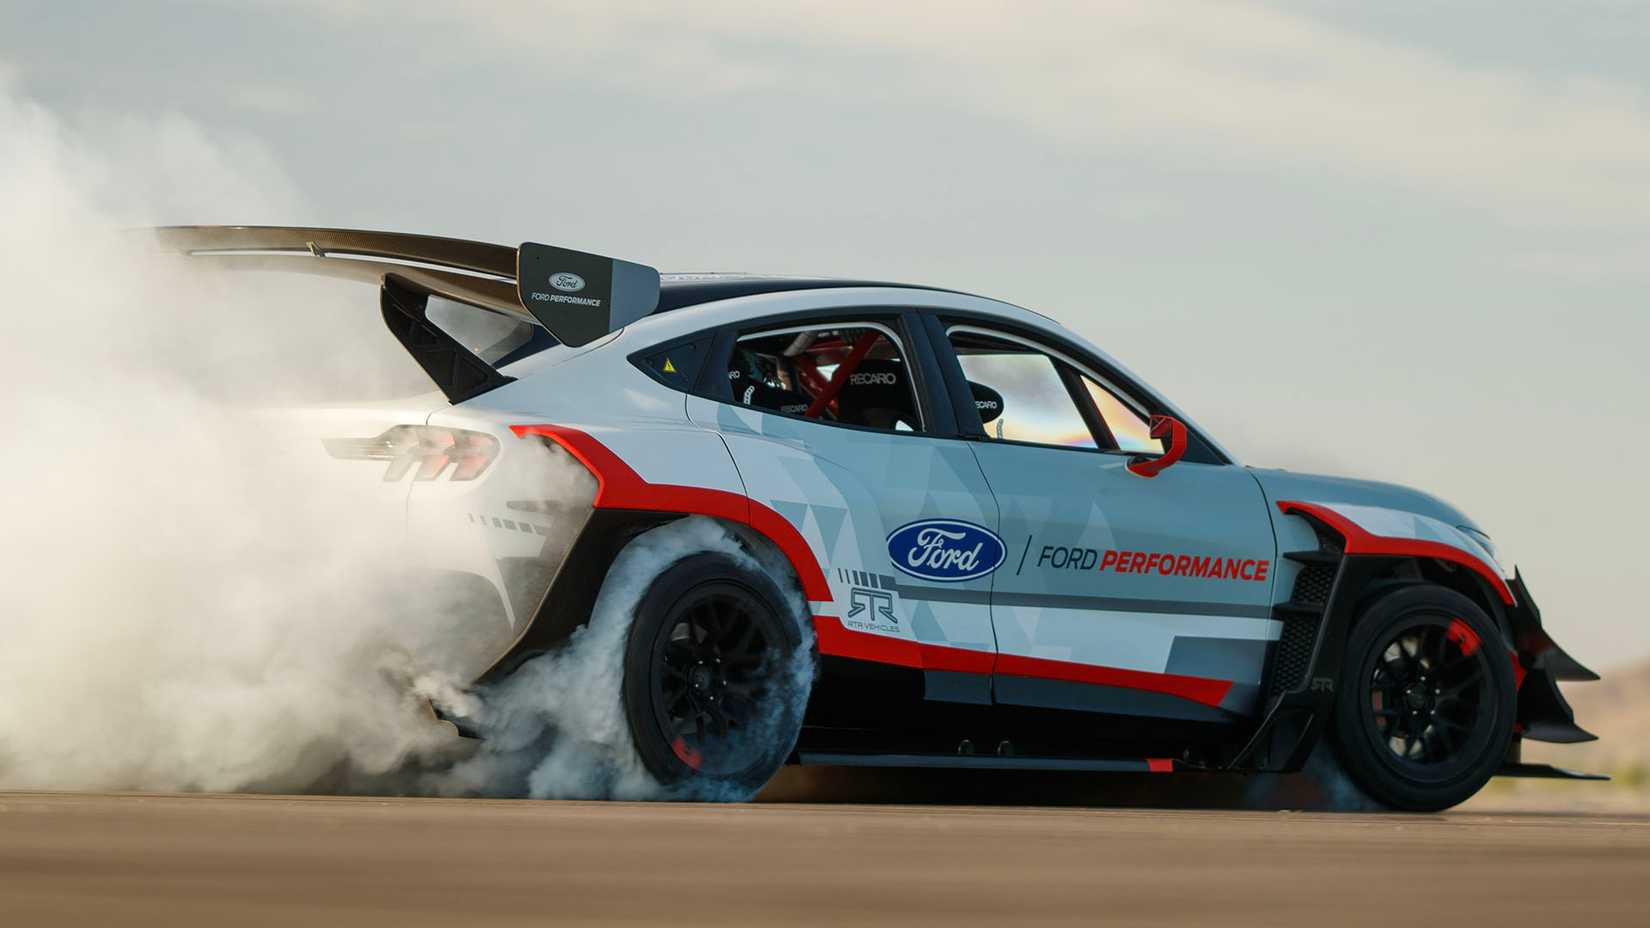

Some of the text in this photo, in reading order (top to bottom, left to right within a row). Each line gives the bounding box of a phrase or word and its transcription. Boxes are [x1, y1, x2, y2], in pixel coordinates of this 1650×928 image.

[555, 275, 577, 288] Ford
[531, 292, 601, 307] FORD PERFORMANCE
[850, 372, 896, 384] RECARO
[974, 400, 998, 409] ECARO
[907, 526, 985, 572] Ford
[1037, 546, 1270, 582] FORD PERFORMANCE
[864, 623, 901, 633] VEHICLES
